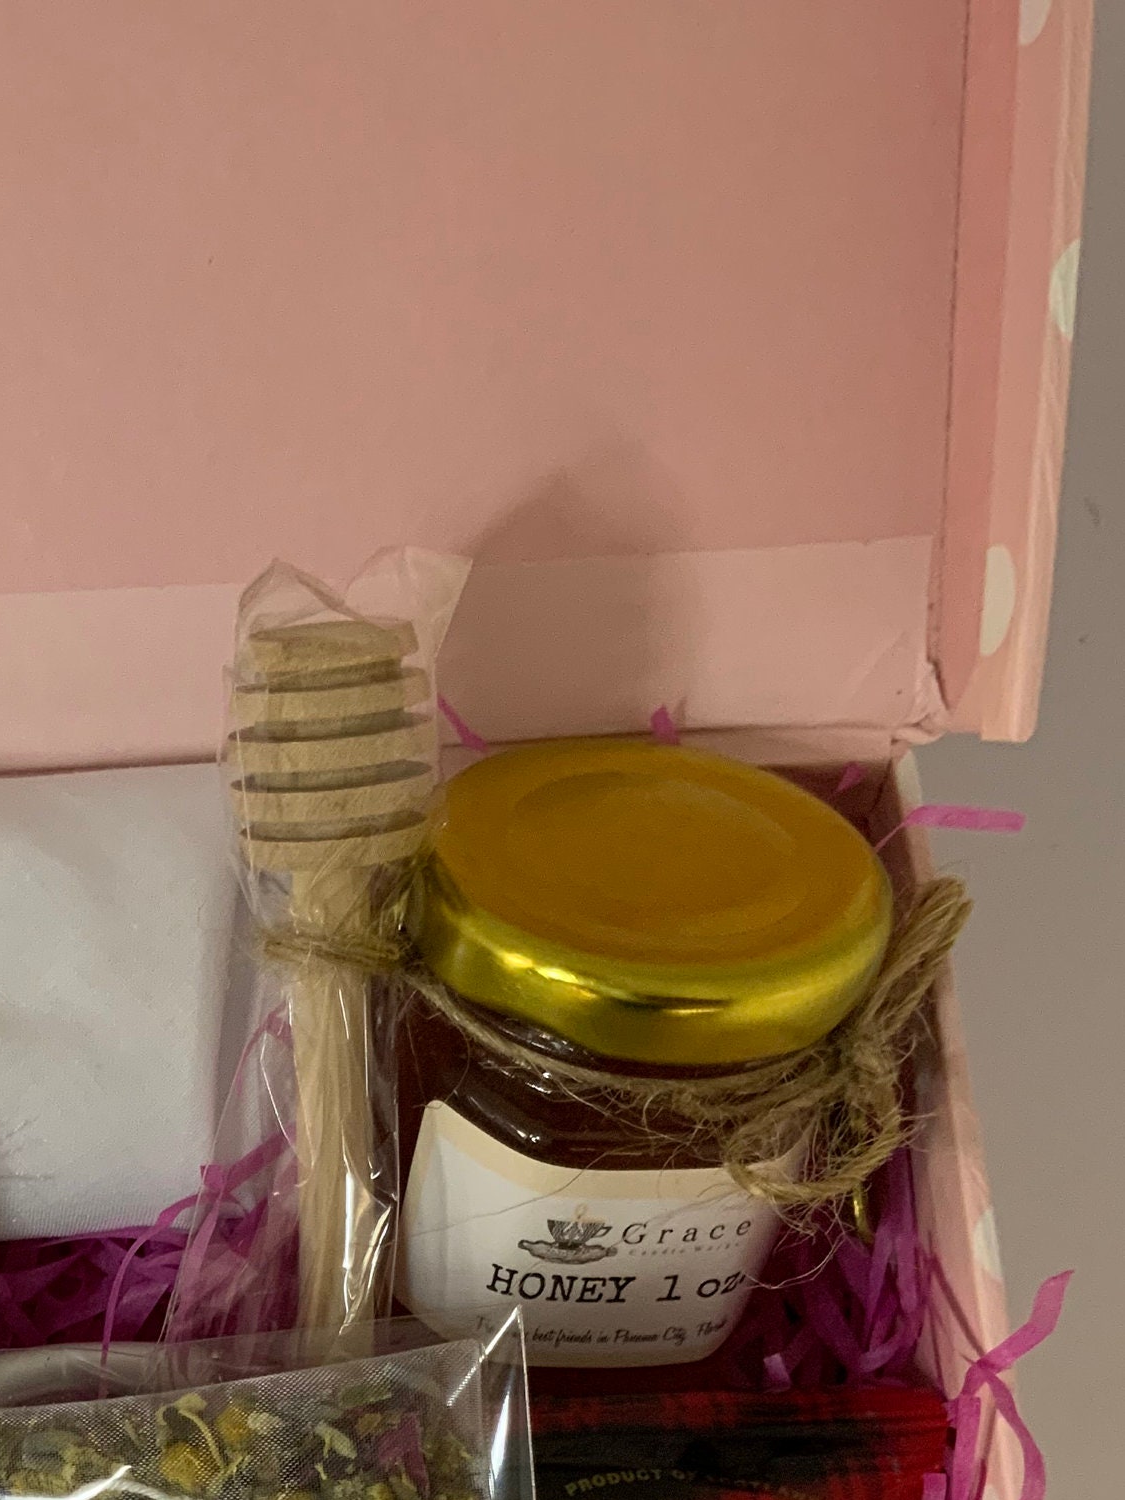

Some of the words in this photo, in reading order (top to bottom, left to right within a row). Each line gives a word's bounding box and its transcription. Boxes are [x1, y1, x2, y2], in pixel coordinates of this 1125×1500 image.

[623, 1220, 751, 1245] Grace
[487, 1264, 636, 1303] HONEY
[656, 1274, 681, 1301] 1
[564, 1468, 663, 1496] PRODUCT
